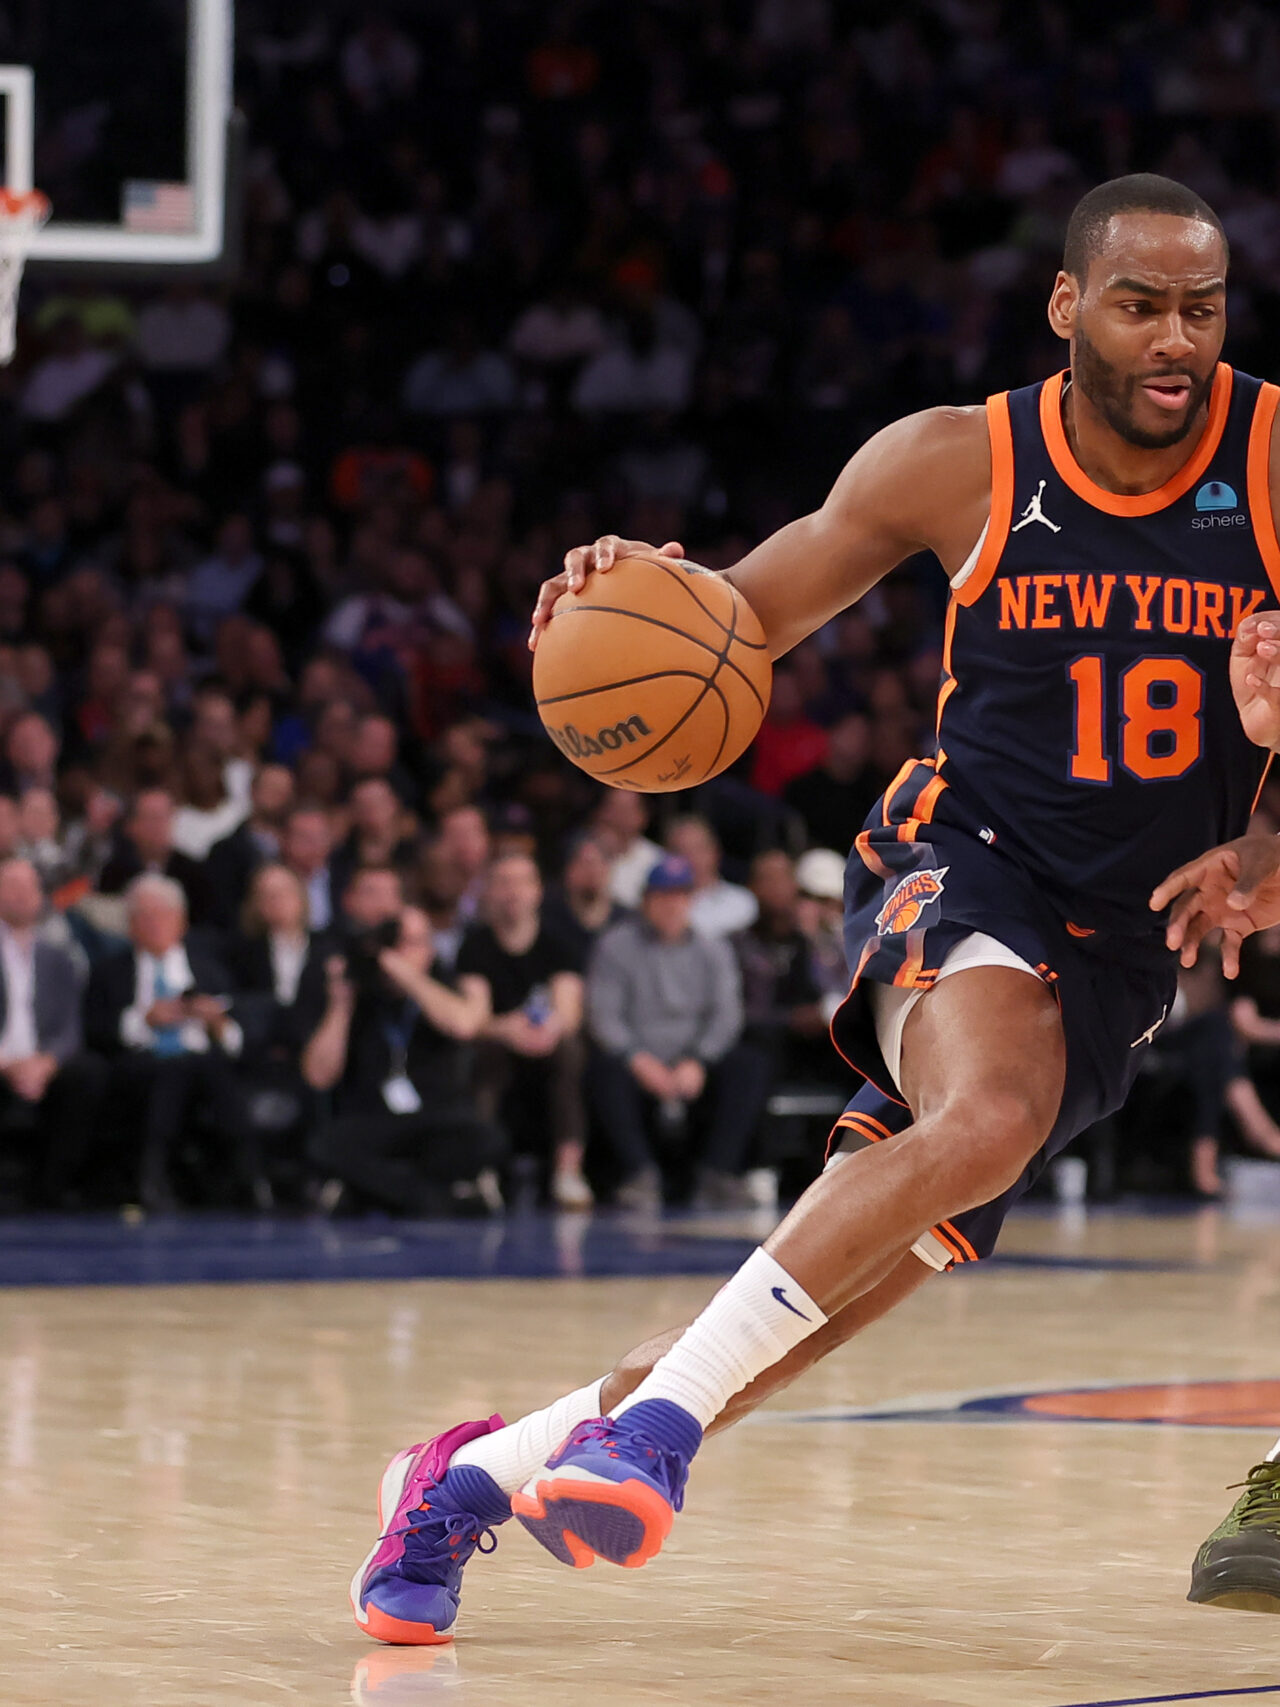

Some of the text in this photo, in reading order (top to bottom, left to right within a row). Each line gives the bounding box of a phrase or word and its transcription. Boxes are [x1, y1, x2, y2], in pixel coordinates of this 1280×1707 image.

[1191, 513, 1246, 530] sphere
[997, 574, 1266, 638] NEW YORK
[1065, 653, 1206, 786] 18
